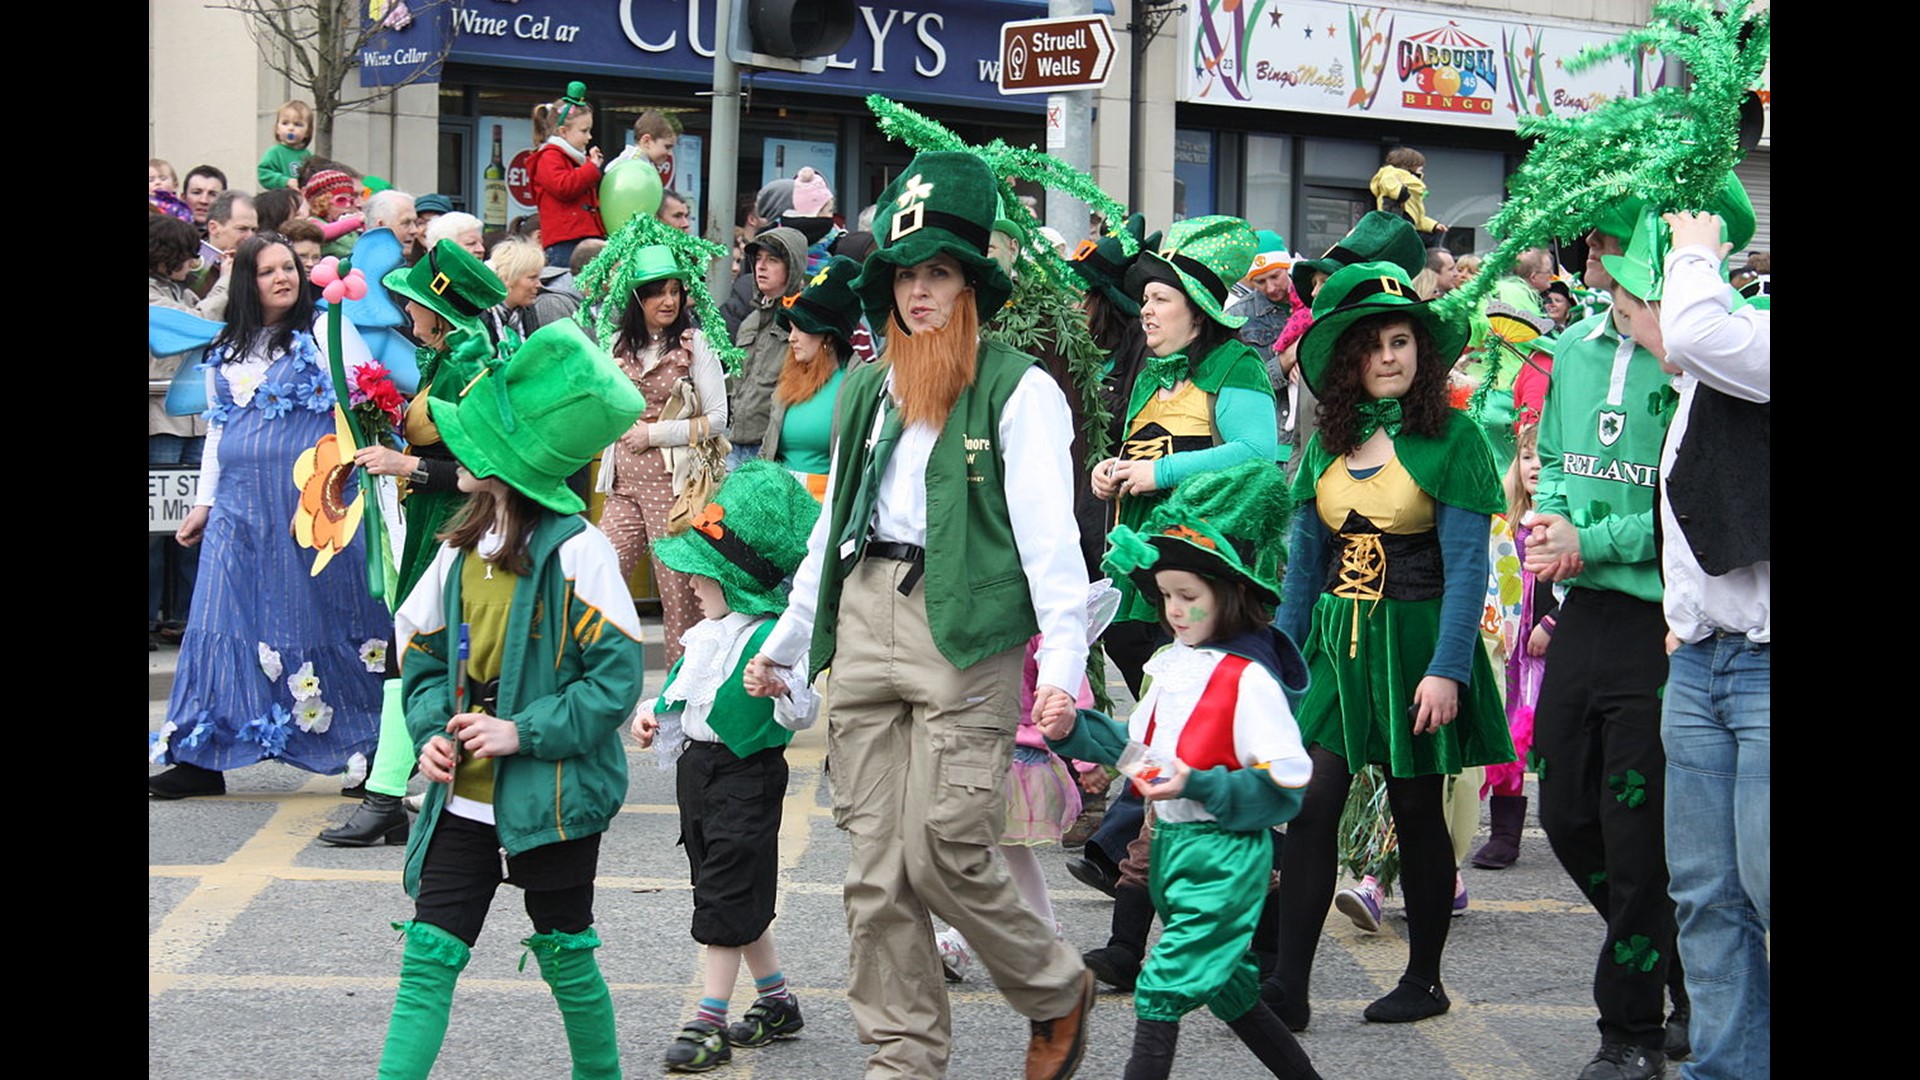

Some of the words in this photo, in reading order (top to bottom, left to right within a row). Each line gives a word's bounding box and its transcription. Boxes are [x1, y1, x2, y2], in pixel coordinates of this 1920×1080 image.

[451, 8, 508, 37] Wine
[1032, 29, 1087, 53] Struell
[364, 51, 392, 67] Wine
[394, 48, 428, 65] Cellar
[1037, 56, 1081, 77] Wells
[1223, 59, 1234, 70] 23
[1397, 40, 1497, 93] CAROUSEL
[1463, 77, 1477, 88] 45
[1405, 93, 1491, 111] BINGO
[177, 474, 200, 497] ST
